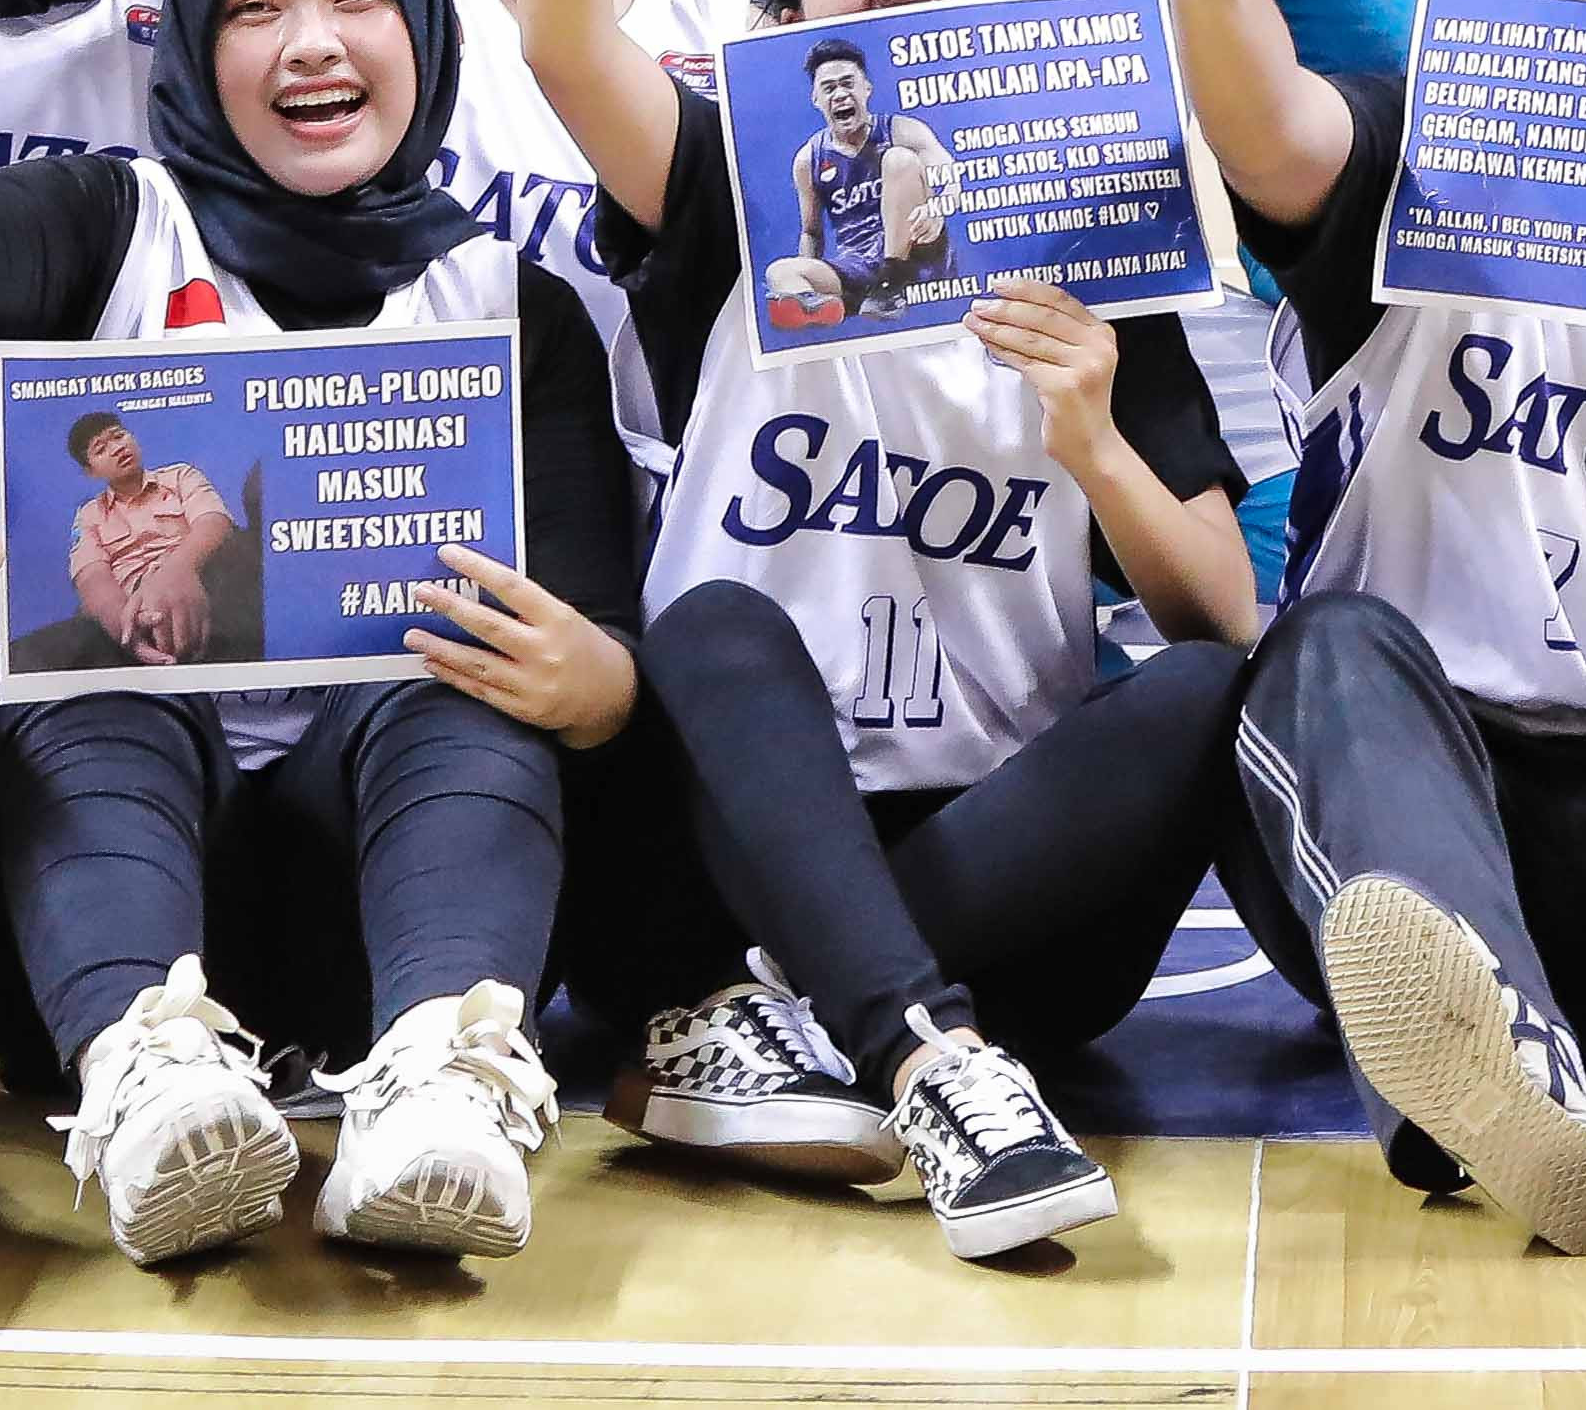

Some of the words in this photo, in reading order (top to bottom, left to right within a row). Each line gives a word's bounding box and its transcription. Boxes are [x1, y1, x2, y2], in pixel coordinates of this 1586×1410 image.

[889, 26, 975, 67] SATOE
[977, 18, 1057, 55] TANPA
[1058, 11, 1143, 49] KAMOE
[1432, 18, 1488, 45] KAMU
[1490, 21, 1550, 50] LIHAT
[898, 63, 1040, 111] BUKANLAH
[1043, 54, 1150, 91] APA-APA
[1423, 49, 1452, 74] INI
[1454, 53, 1530, 81] ADALAH
[1424, 81, 1488, 109] BELUM
[1491, 89, 1574, 119] PERNAH
[952, 122, 1021, 153] SMOGA
[1022, 116, 1067, 144] LKAS
[1069, 110, 1140, 139] SEMBUH
[925, 156, 1001, 189] KAPTEN
[1003, 148, 1064, 178] SATOE,
[1066, 144, 1101, 169] KLO
[1103, 138, 1170, 166] SEMBUH
[1415, 144, 1517, 178] MEMBAWA
[925, 193, 957, 219] KU
[959, 179, 1068, 214] HADIAHKAN
[1070, 168, 1182, 200] SWEETSIXTEEN
[967, 213, 1033, 244] UNTUK
[1035, 207, 1096, 235] KAMOE
[1396, 229, 1456, 252] SEMOGA
[1460, 236, 1515, 258] MASUK
[1436, 210, 1489, 232] ALLAH,
[1500, 216, 1531, 236] BEG
[1533, 221, 1574, 241] YOUR
[905, 275, 983, 306] MICHAEL
[1066, 258, 1104, 283] JAYA
[1106, 254, 1143, 278] JAYA
[1144, 249, 1187, 275] JAYA!
[139, 365, 206, 390] BAGOES
[244, 364, 503, 413] PLONGA-PLONGO
[282, 414, 467, 458] HALUSINASI
[317, 464, 427, 505] MASUK
[722, 413, 1050, 572] SATOE
[269, 508, 484, 554] SWEETSIXTEEN
[852, 595, 947, 729] 11
